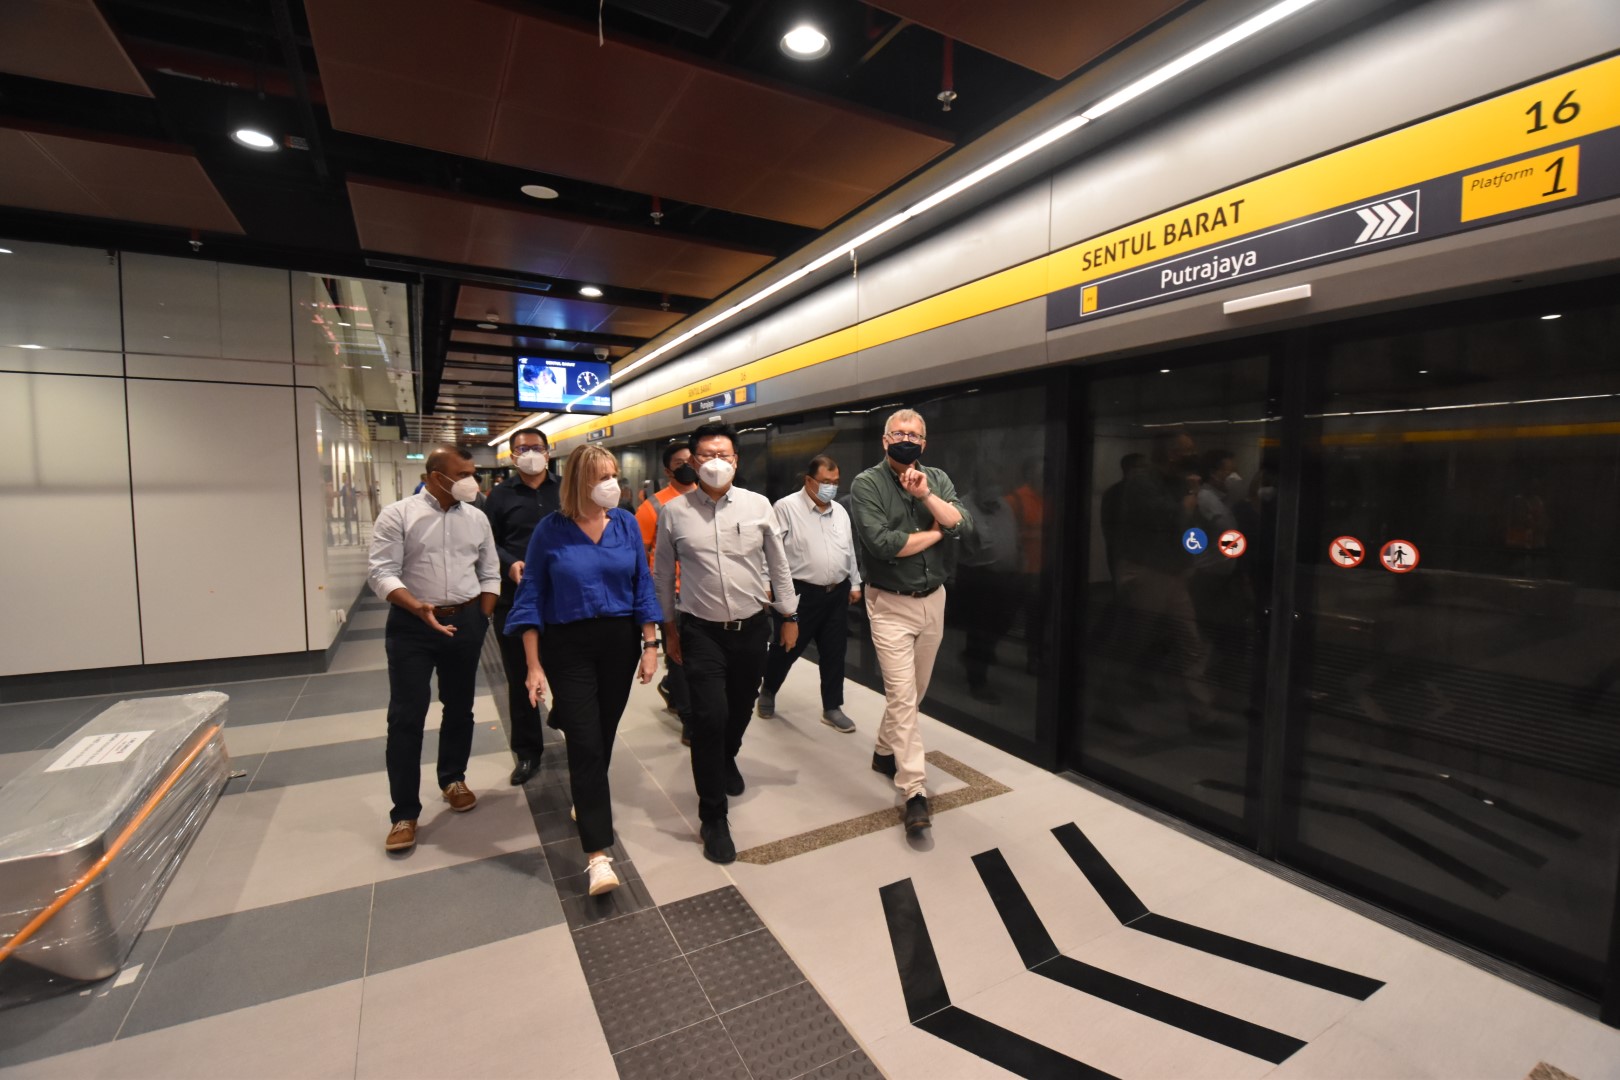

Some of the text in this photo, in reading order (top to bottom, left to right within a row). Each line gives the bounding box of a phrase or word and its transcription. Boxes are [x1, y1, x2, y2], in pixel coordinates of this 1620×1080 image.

[1524, 88, 1581, 135] 16
[1470, 156, 1567, 197] Platform 1
[1082, 199, 1245, 272] SENTUL BARAT
[1160, 250, 1257, 289] Putrajaya
